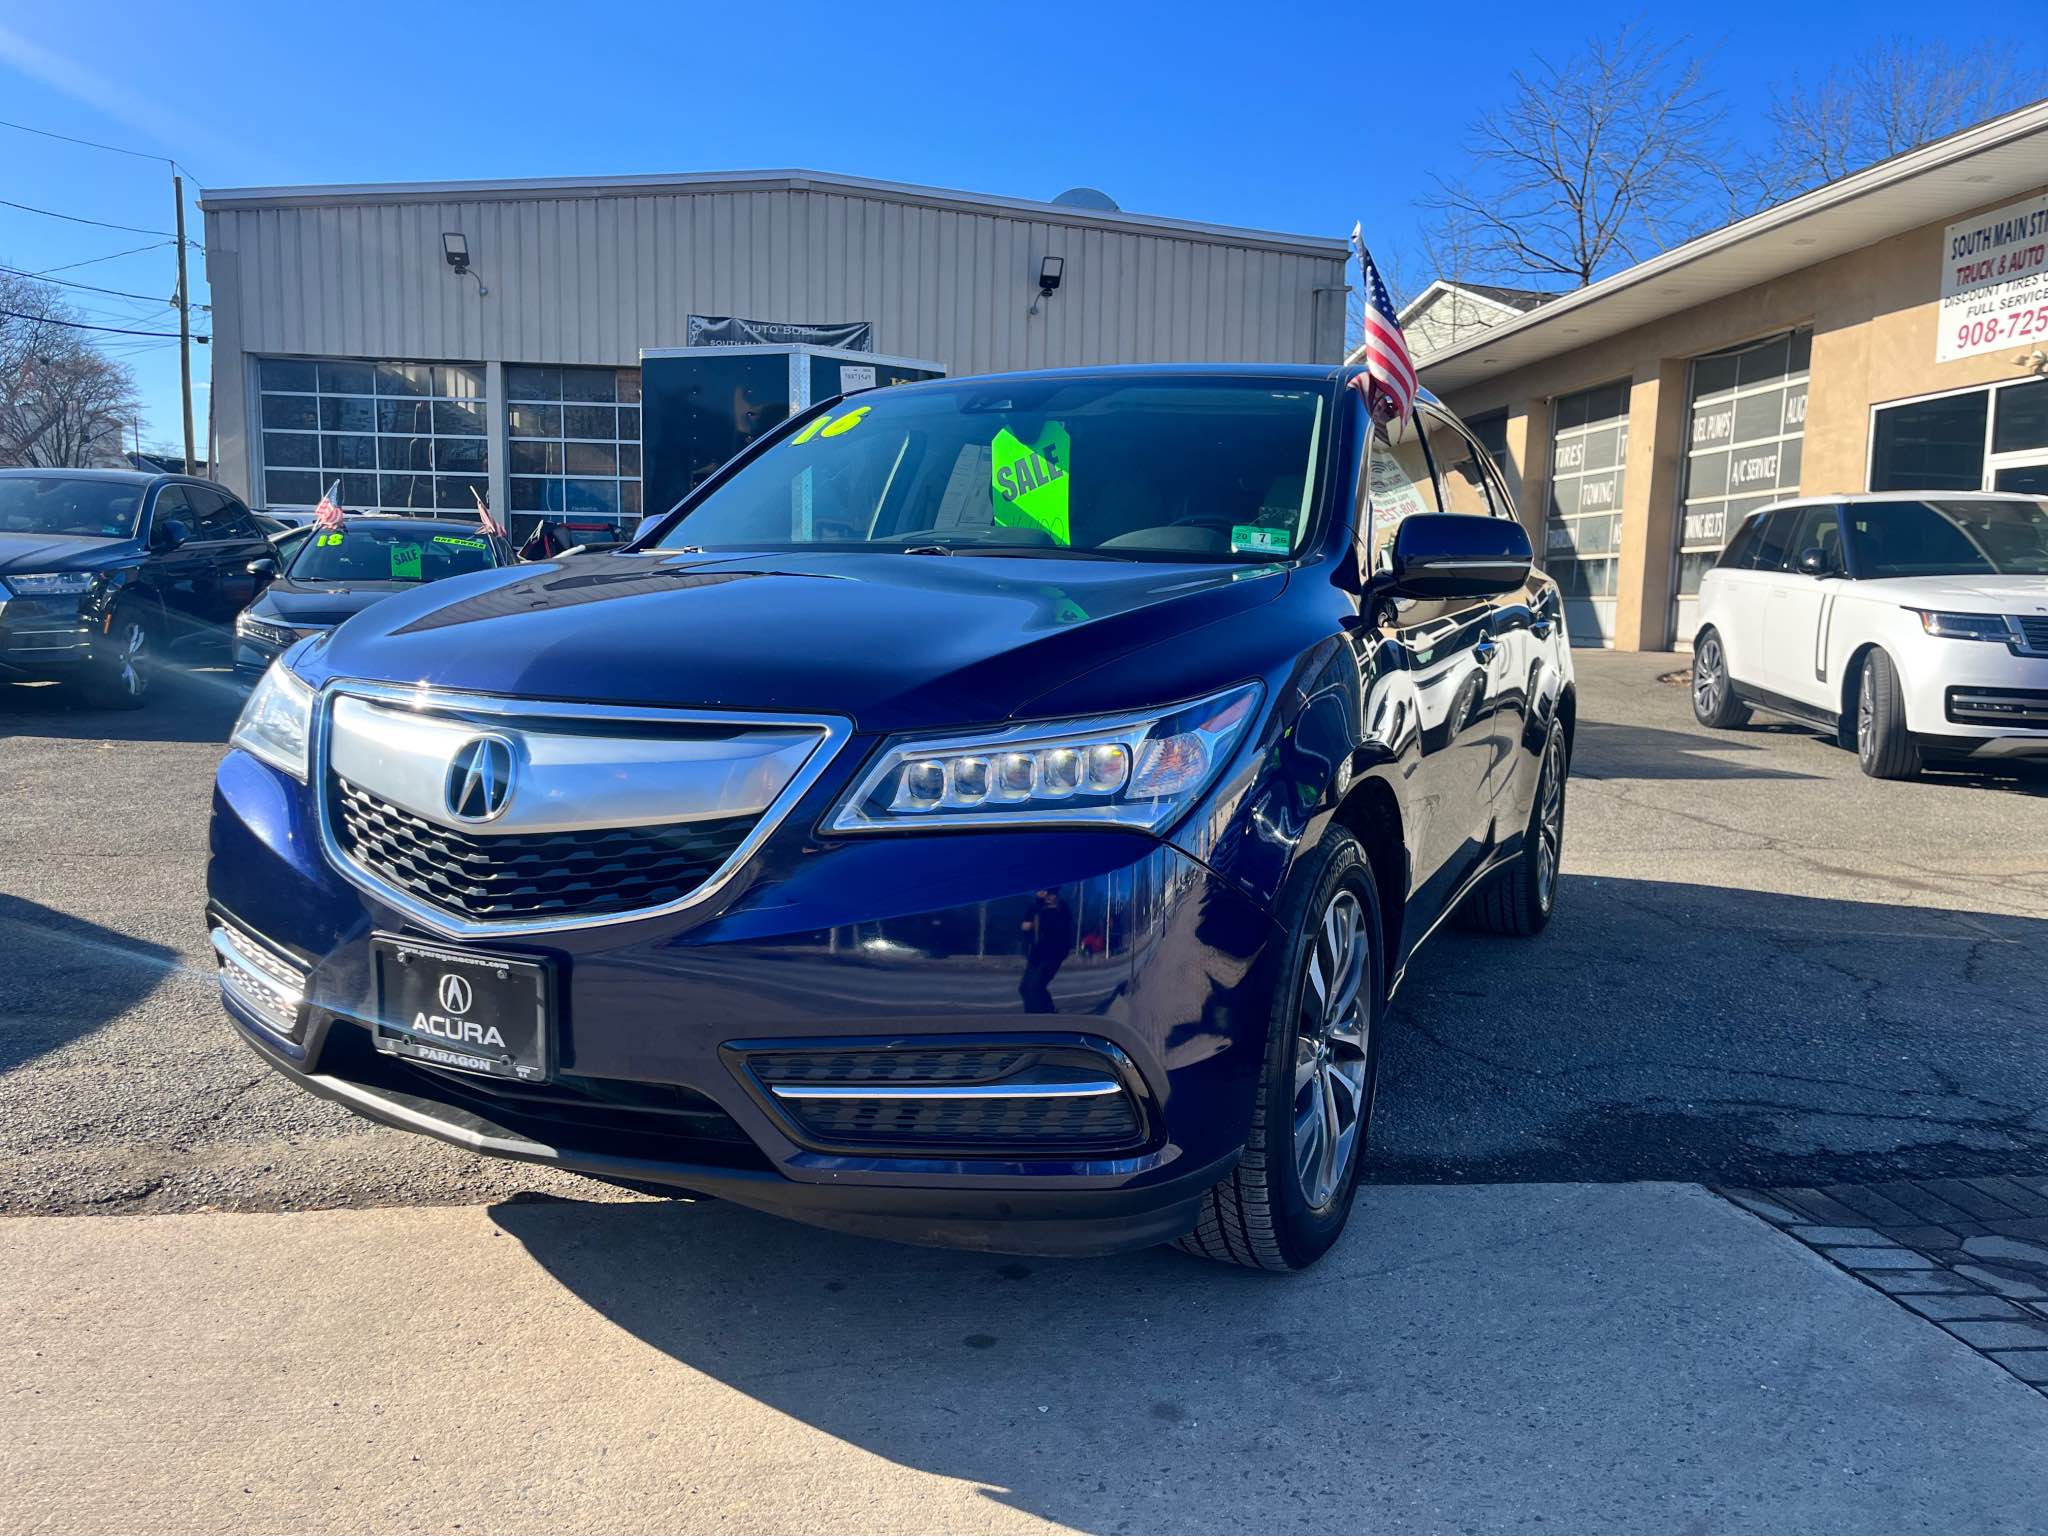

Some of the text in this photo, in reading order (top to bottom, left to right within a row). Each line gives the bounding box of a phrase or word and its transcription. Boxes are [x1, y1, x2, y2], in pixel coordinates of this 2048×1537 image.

[1952, 228, 1991, 260] SOUTH
[1994, 216, 2028, 247] MAIN
[1955, 244, 2046, 287] TRUCK & AUTO
[1944, 283, 2001, 309] DISCOUNT
[2005, 274, 2039, 294] TIRES
[1966, 287, 2048, 319] FULL SERVICE
[743, 325, 779, 335] AUTO
[791, 405, 872, 446] 16
[1707, 411, 1732, 440] PUMPS
[1556, 443, 1583, 469] TIRES
[1746, 455, 1777, 481] SERVICE
[996, 442, 1064, 502] SALE
[1582, 480, 1614, 506] TOWING
[1259, 533, 1267, 543] 7
[1704, 511, 1724, 538] BELTS
[316, 532, 344, 548] 18
[393, 549, 419, 566] SALE
[412, 1012, 506, 1048] ACURA
[418, 1048, 492, 1072] PARAGON
